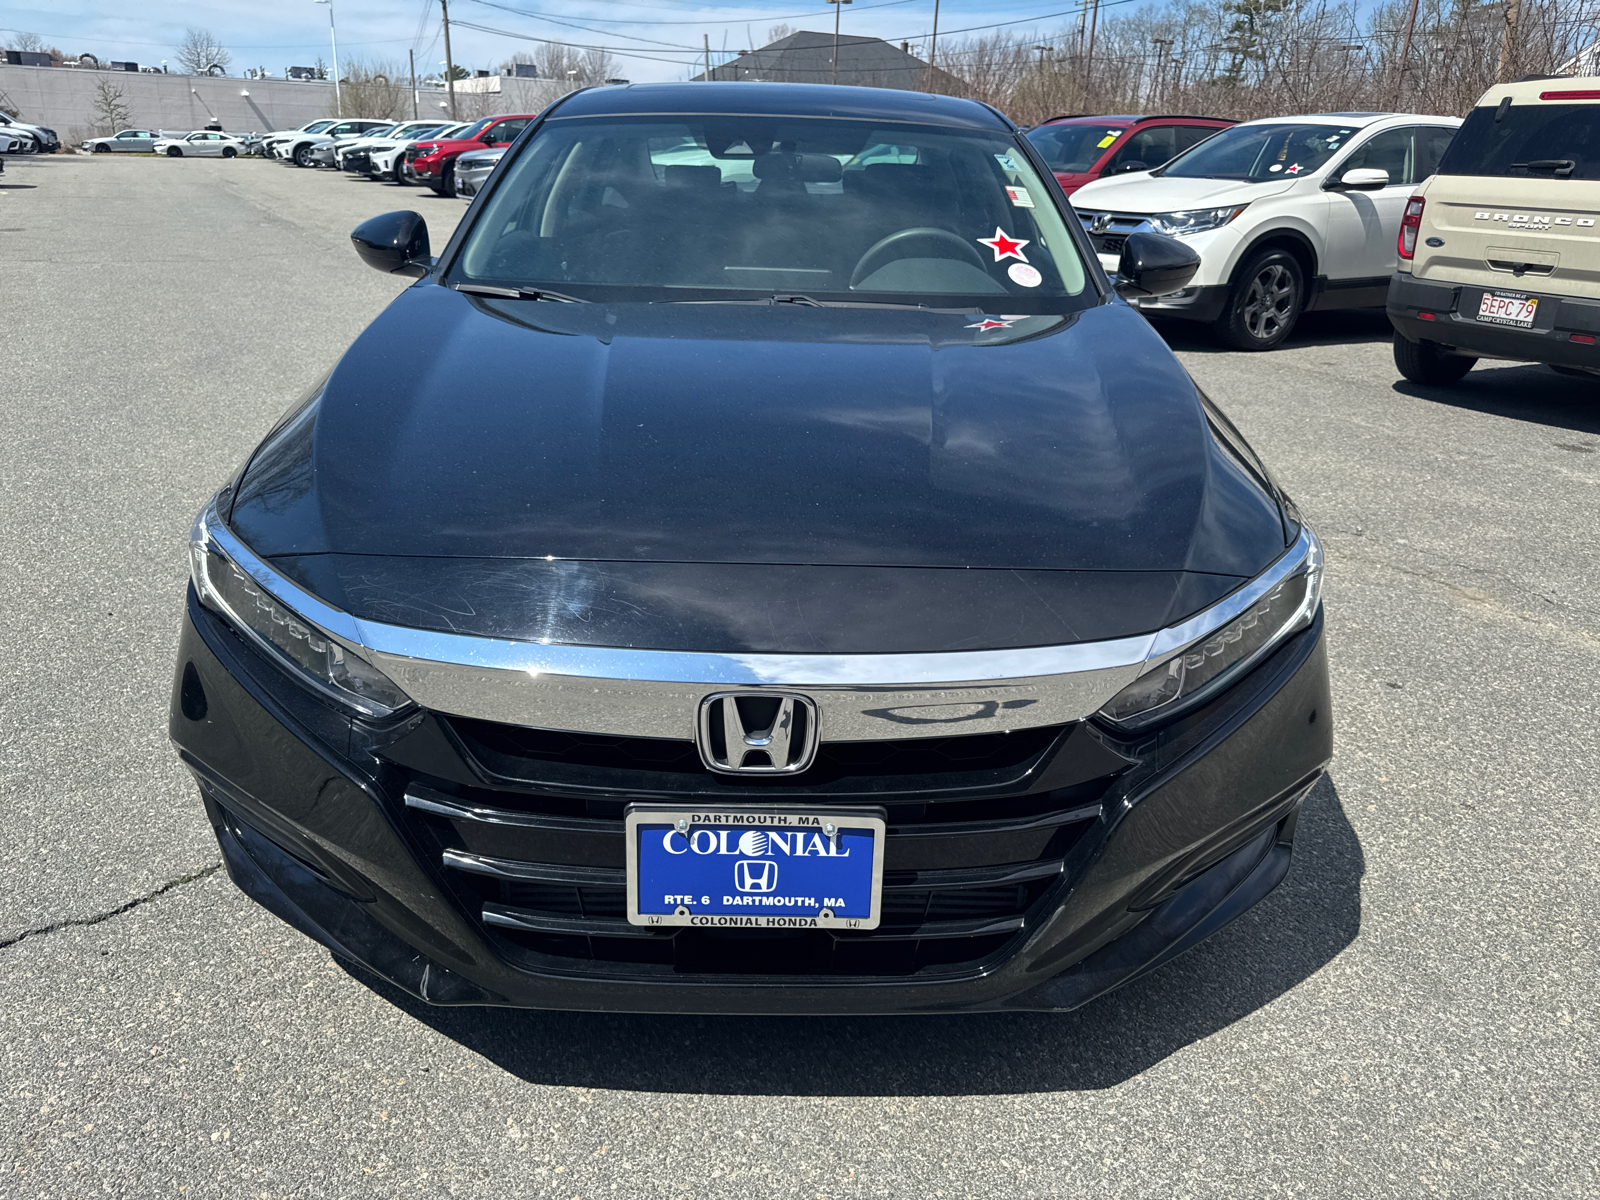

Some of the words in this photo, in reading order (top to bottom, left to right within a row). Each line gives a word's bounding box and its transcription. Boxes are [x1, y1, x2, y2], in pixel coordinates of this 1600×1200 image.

[1474, 212, 1595, 227] BRONCO
[1508, 222, 1551, 230] SPORT
[1481, 298, 1514, 316] 5EPC
[1516, 303, 1534, 318] 79
[1492, 317, 1516, 326] CRYSTAL
[691, 814, 793, 825] DARTMOUTH,
[797, 816, 821, 826] MA
[662, 829, 850, 857] COLONIAL
[664, 895, 697, 905] RTE.
[701, 895, 711, 905] 6
[722, 895, 819, 908] DARTMOUTH,
[823, 897, 846, 908] MA
[690, 916, 762, 926] COLONIAL
[766, 917, 818, 927] HONDA
